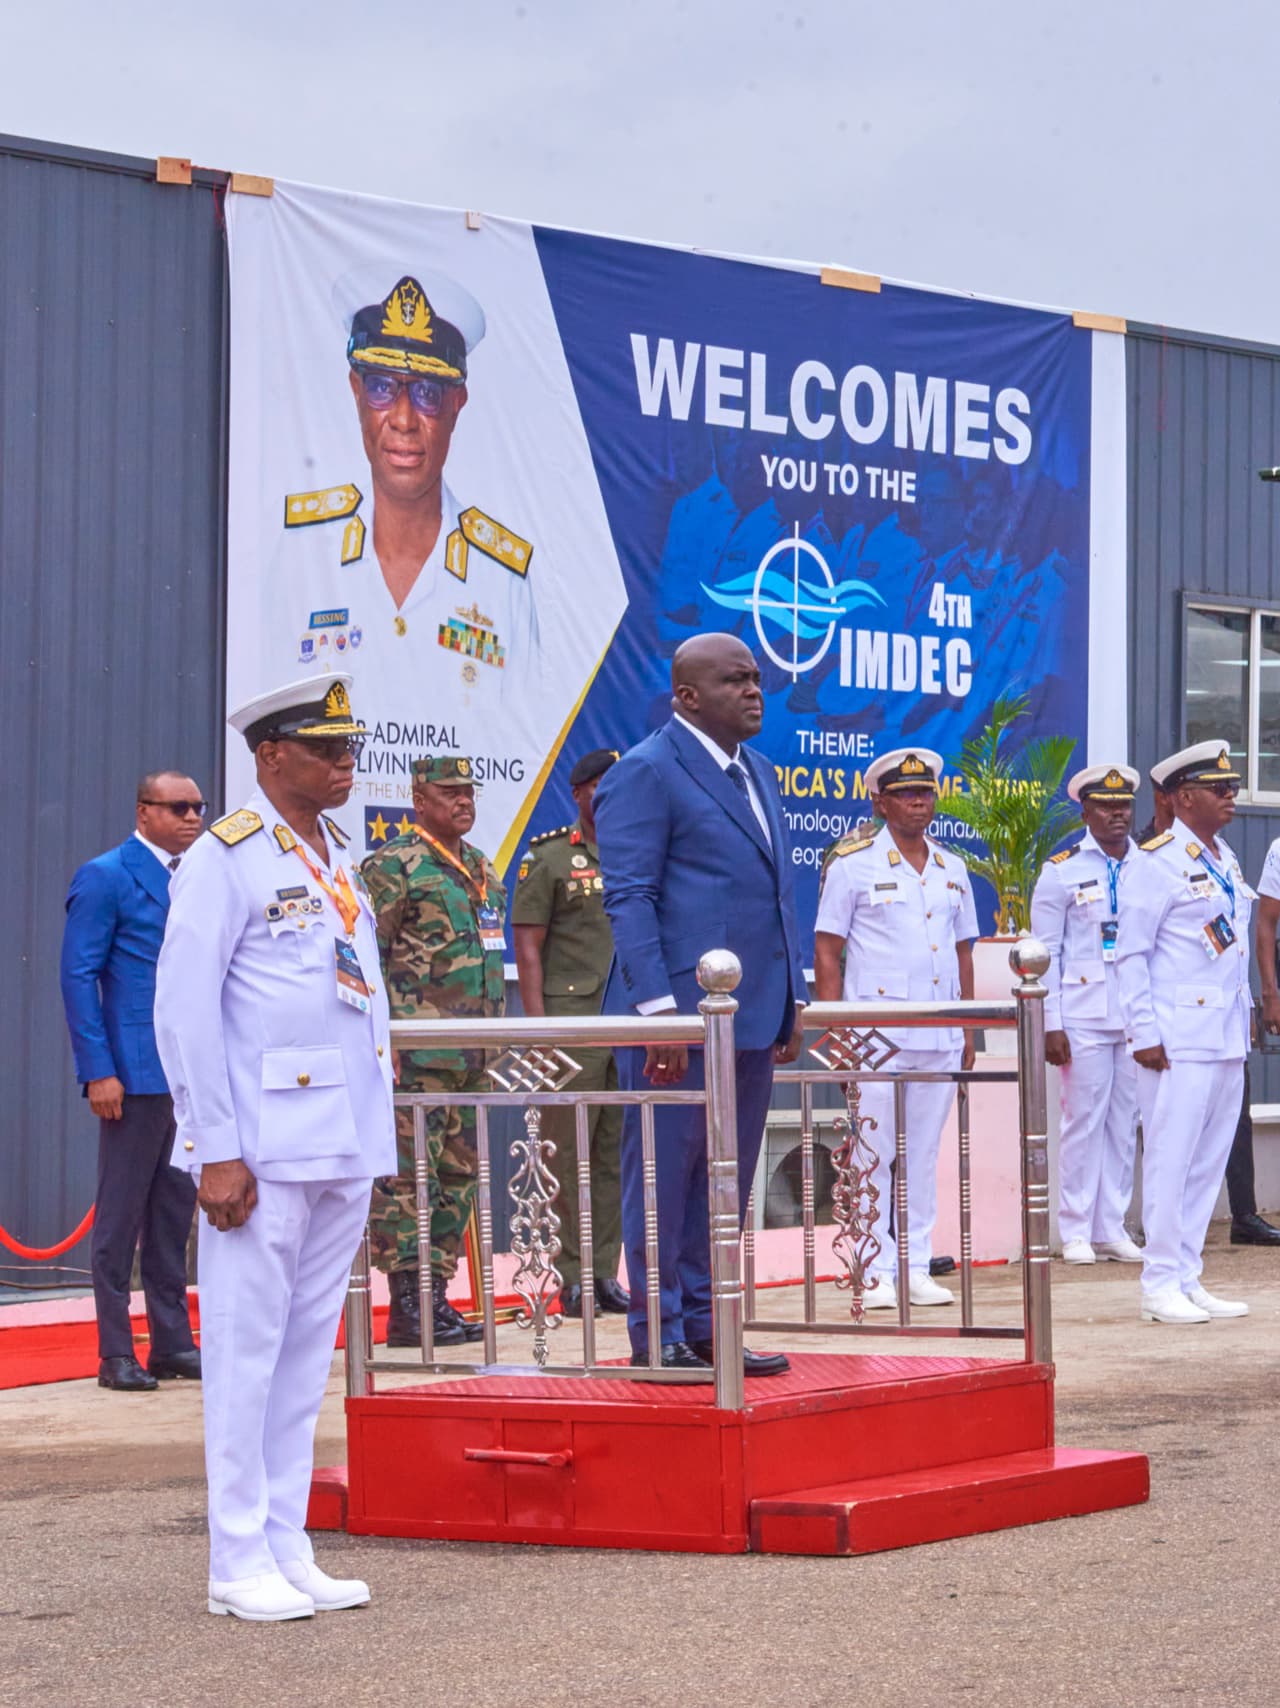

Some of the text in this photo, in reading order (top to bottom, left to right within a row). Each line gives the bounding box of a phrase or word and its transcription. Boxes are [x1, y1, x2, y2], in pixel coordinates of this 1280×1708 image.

[630, 333, 1032, 465] WELCOMES
[760, 454, 917, 504] YOU TO THE
[928, 582, 973, 629] 4TH
[839, 627, 973, 697] IMDEC
[373, 721, 461, 749] ADMIRAL
[796, 730, 875, 758] THEME:
[468, 756, 525, 782] SING
[774, 765, 847, 800] RICA'S
[366, 782, 392, 799] THE
[782, 806, 852, 838] hnology
